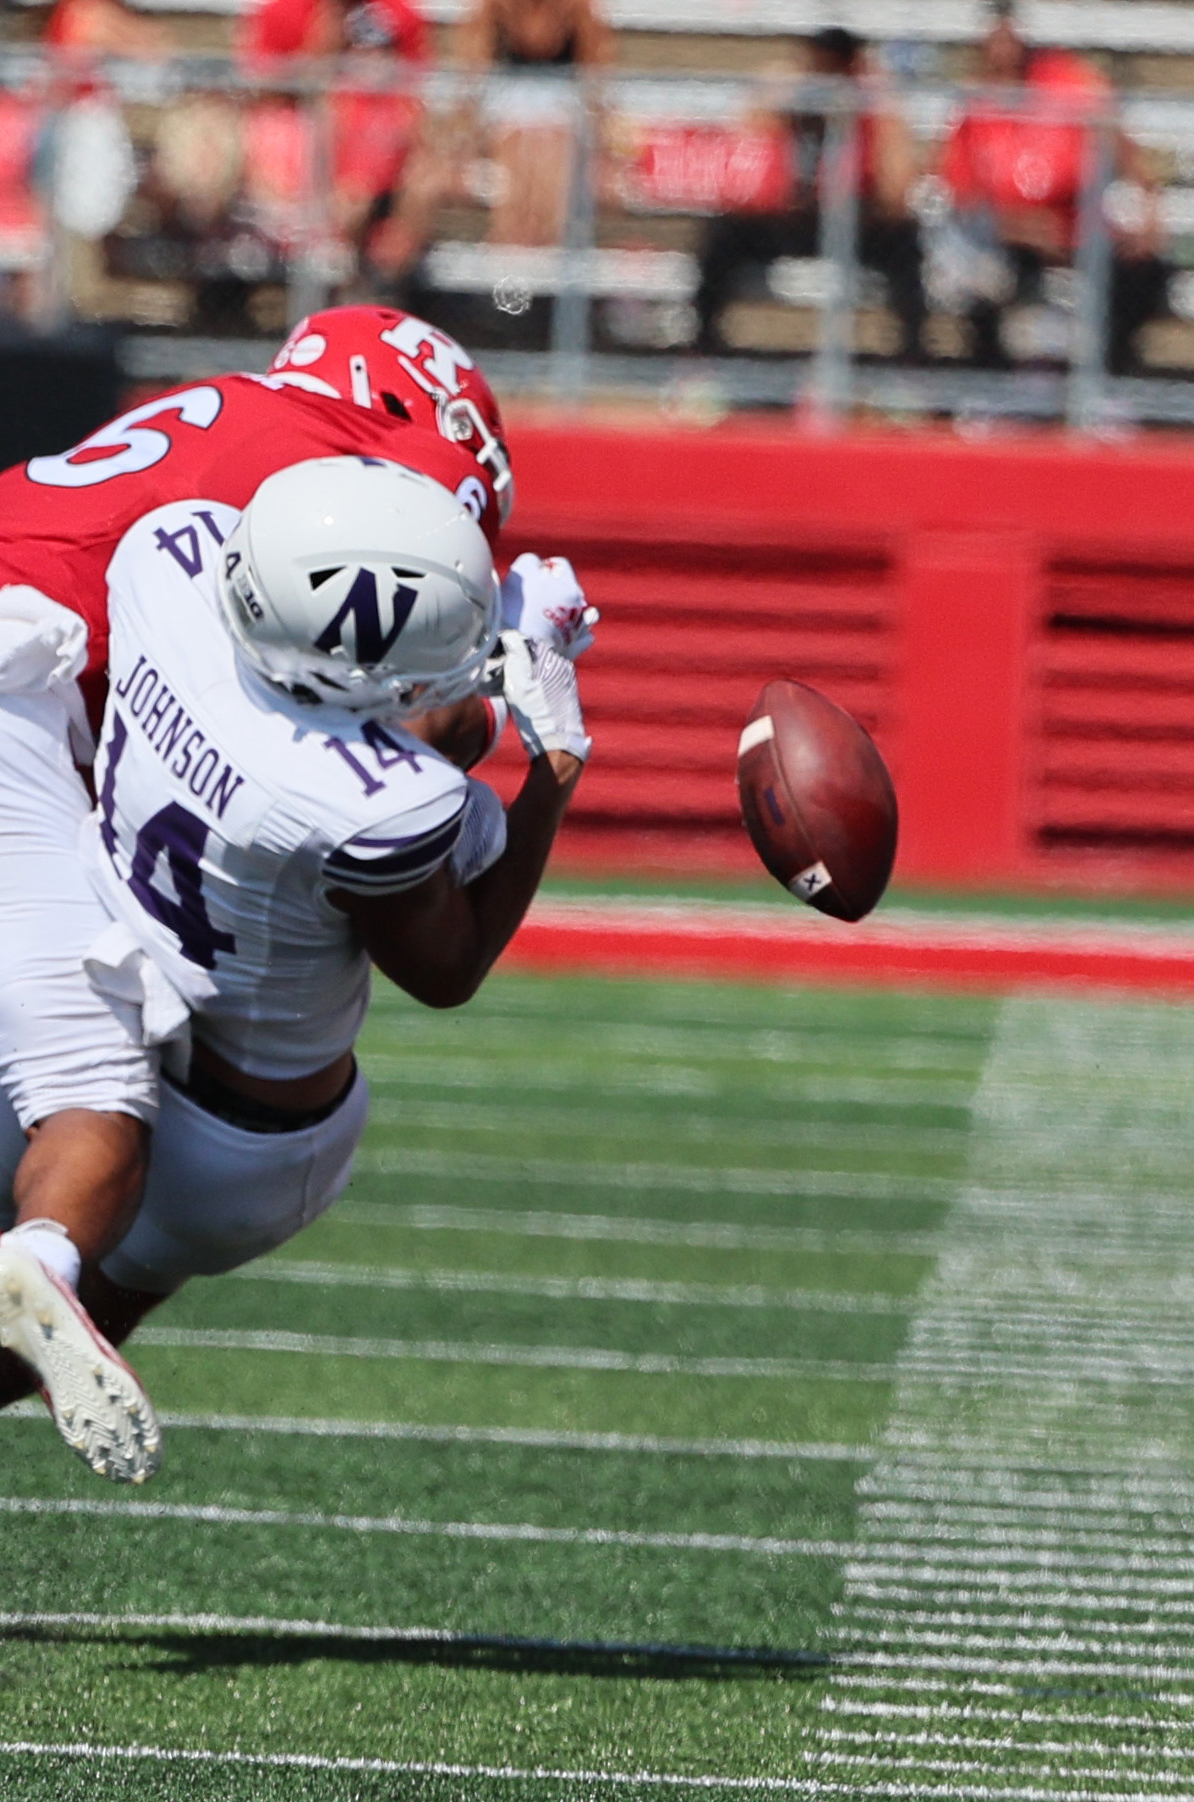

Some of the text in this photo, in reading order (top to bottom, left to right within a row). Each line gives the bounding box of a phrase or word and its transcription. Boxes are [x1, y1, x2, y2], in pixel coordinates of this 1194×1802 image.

[380, 316, 474, 396] R
[25, 385, 223, 488] 6
[152, 510, 226, 580] 14
[314, 567, 419, 665] N
[115, 654, 245, 820] JOHNSON
[323, 720, 424, 798] 14
[99, 708, 238, 971] 14
